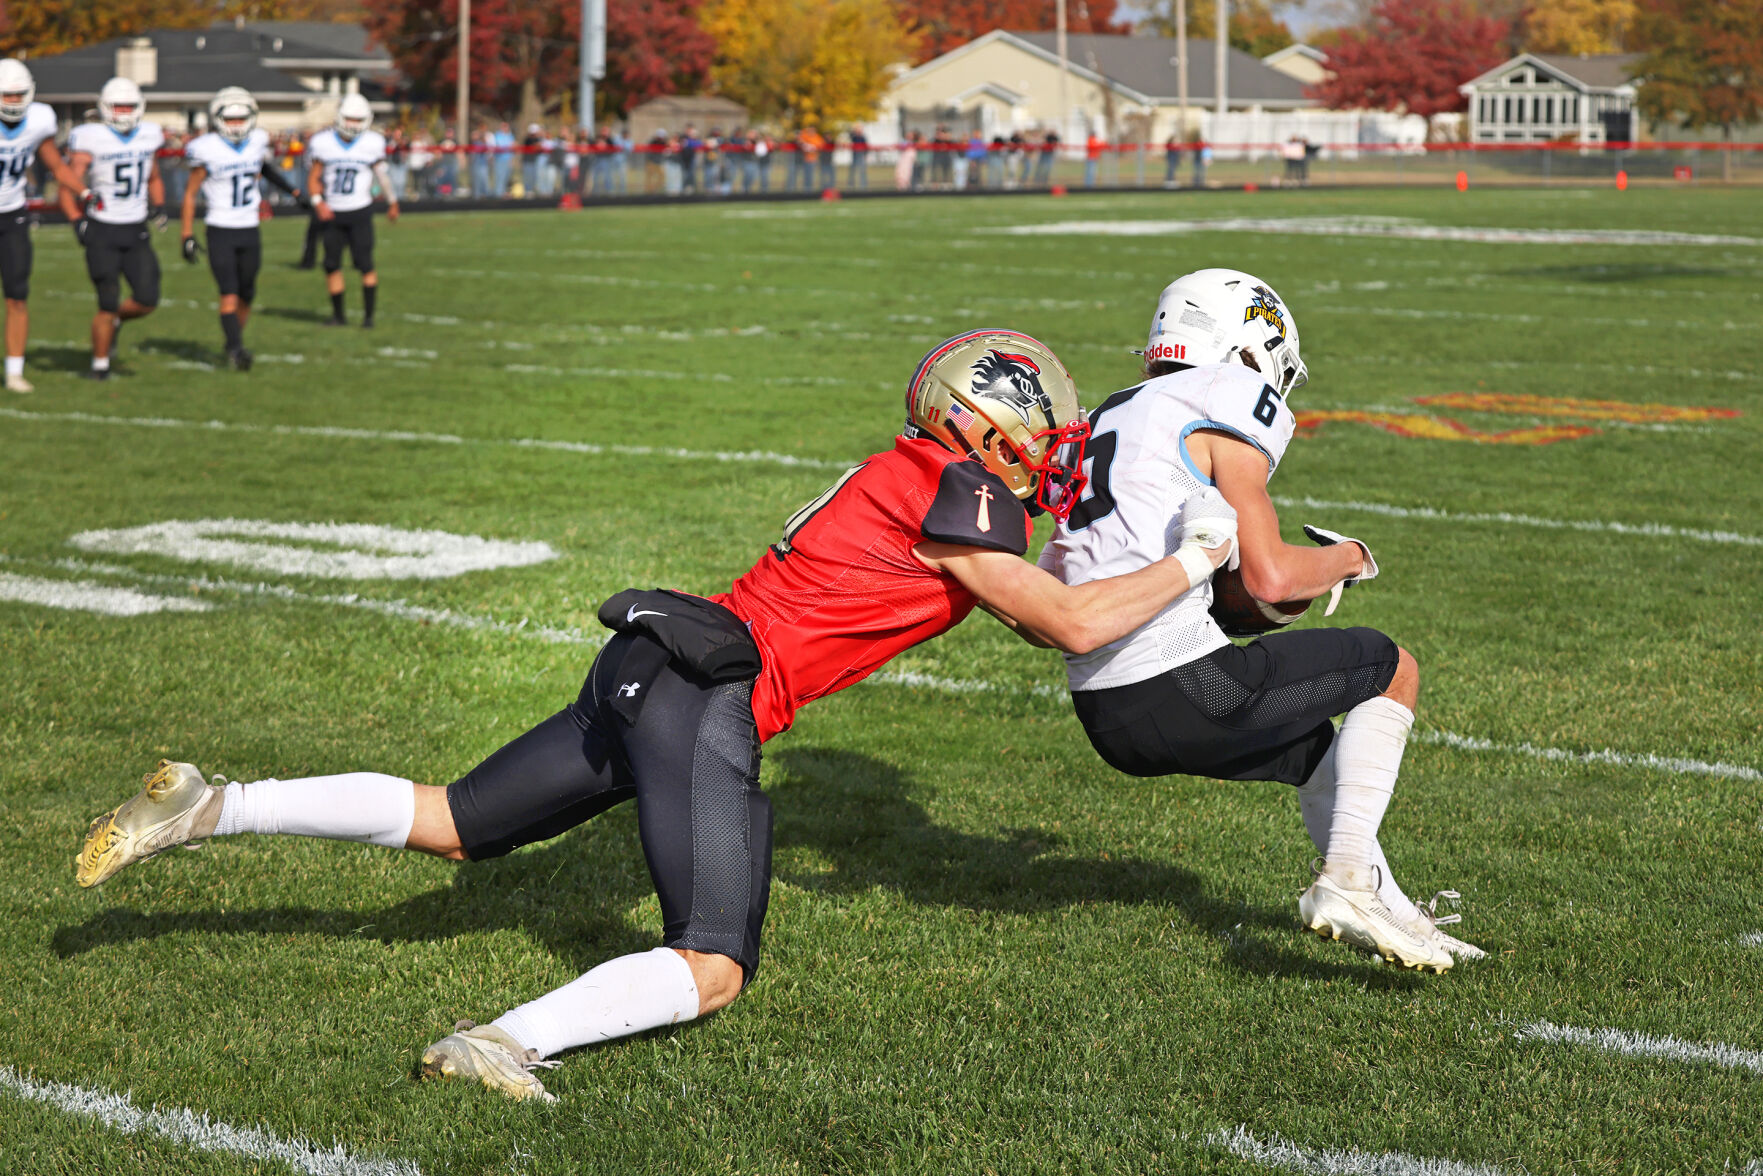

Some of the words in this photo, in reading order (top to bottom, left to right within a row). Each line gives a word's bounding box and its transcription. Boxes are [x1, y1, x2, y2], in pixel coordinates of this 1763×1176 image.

[114, 161, 143, 198] 51
[232, 173, 256, 207] 12
[1253, 306, 1283, 330] PIRATES
[928, 406, 940, 423] 11
[1251, 383, 1282, 428] 6
[1064, 382, 1151, 536] 6
